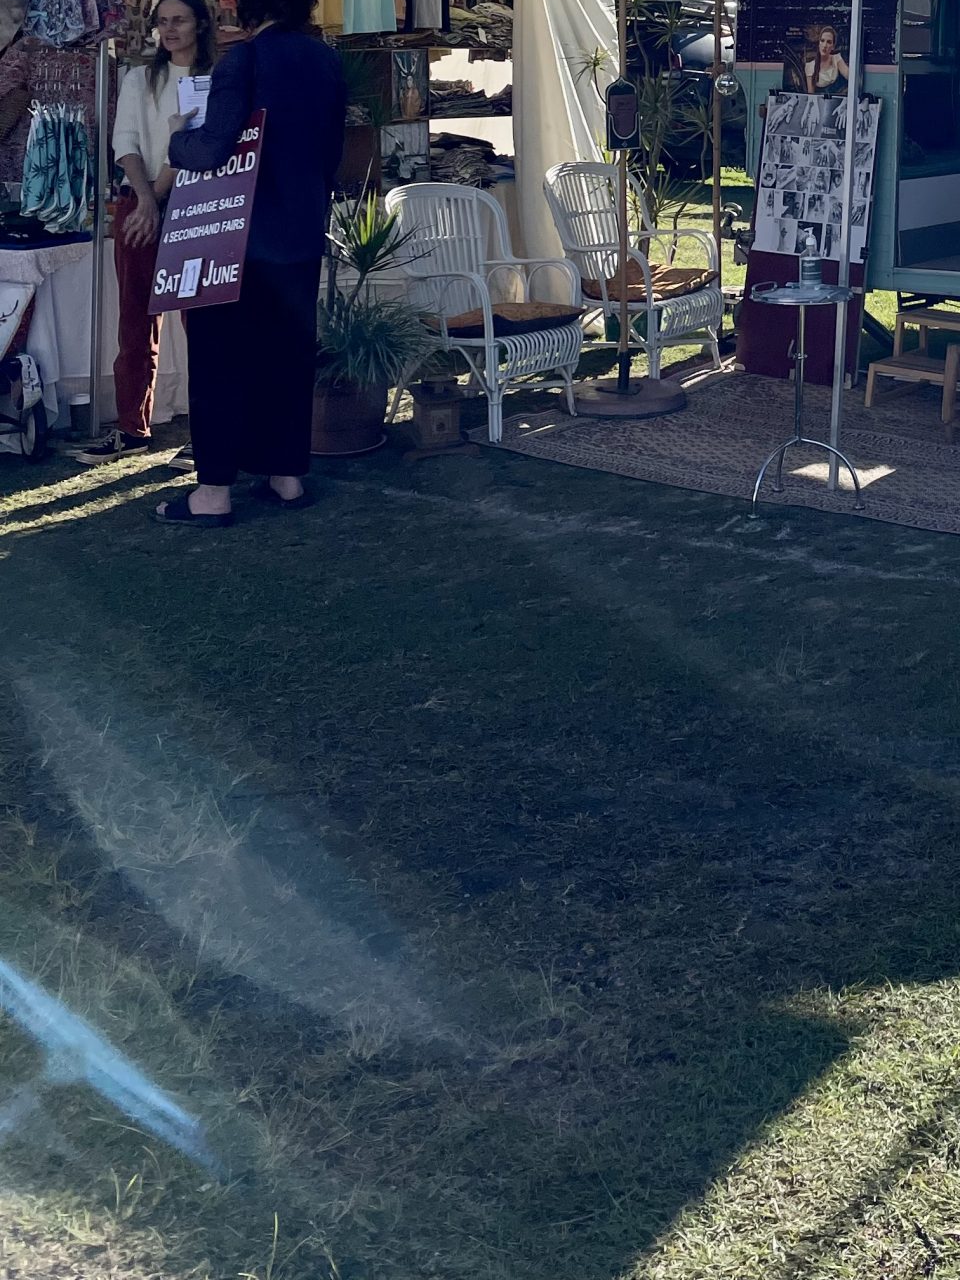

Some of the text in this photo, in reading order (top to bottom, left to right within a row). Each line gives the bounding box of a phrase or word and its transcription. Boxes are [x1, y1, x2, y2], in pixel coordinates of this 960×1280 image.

[236, 126, 259, 143] ADS
[175, 168, 201, 188] OLD
[186, 199, 218, 217] GARAGE
[218, 194, 245, 210] SALES
[163, 217, 245, 244] 4 SECONDHAND FAIRS
